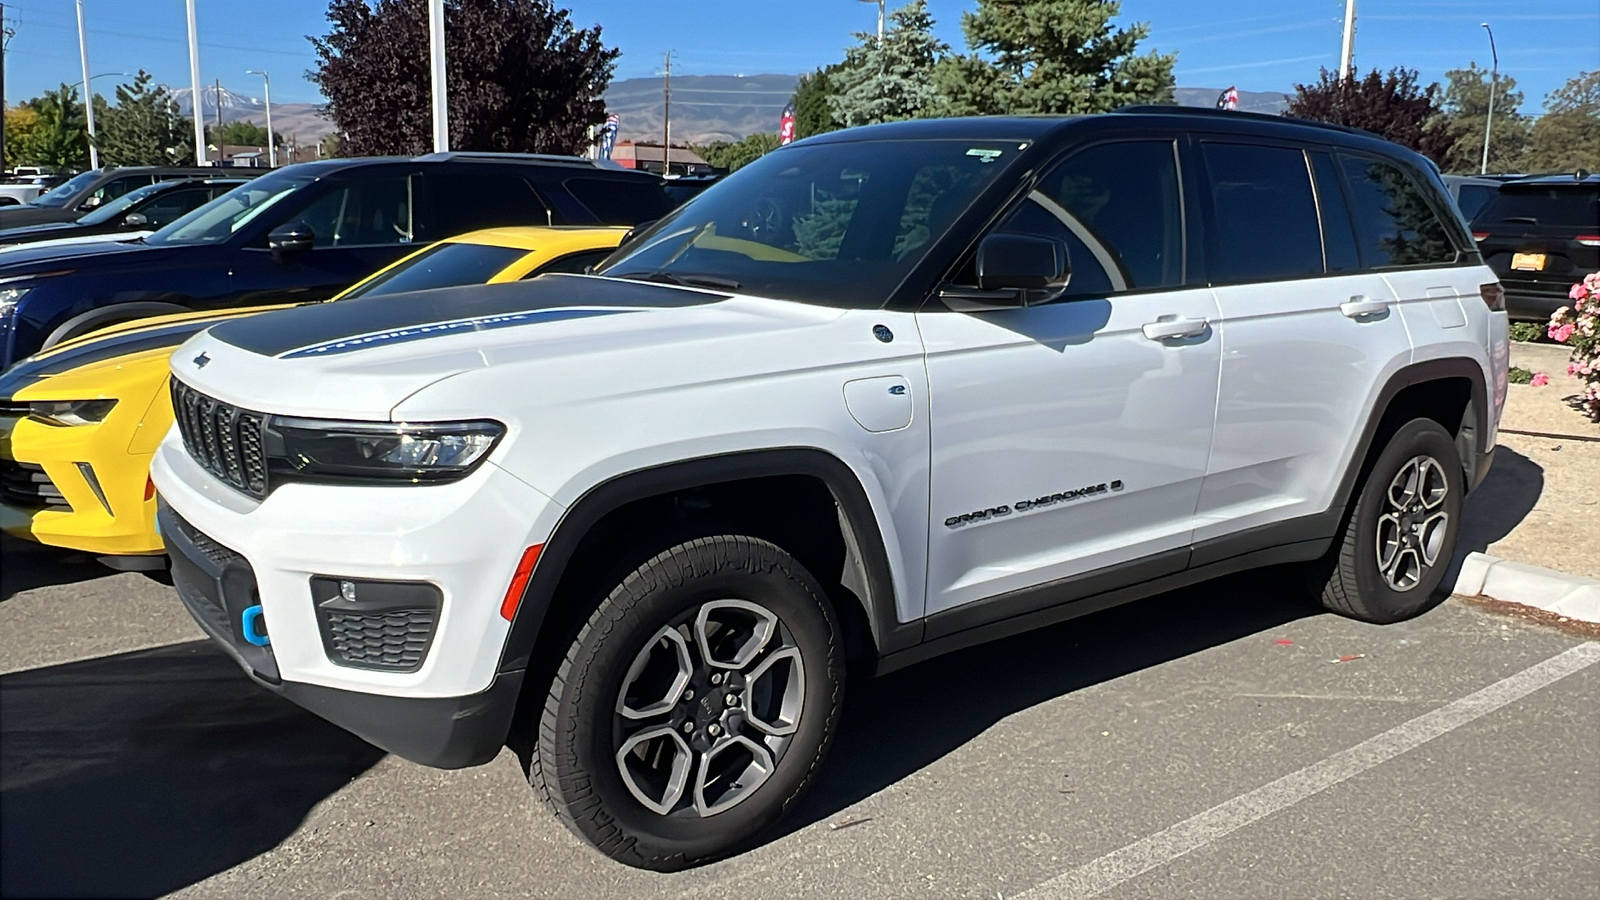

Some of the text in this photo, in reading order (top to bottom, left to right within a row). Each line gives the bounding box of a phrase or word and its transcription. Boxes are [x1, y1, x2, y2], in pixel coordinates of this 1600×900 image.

[305, 315, 528, 353] TRAILHAWK
[944, 483, 1107, 527] GRAND CHEROKEE
